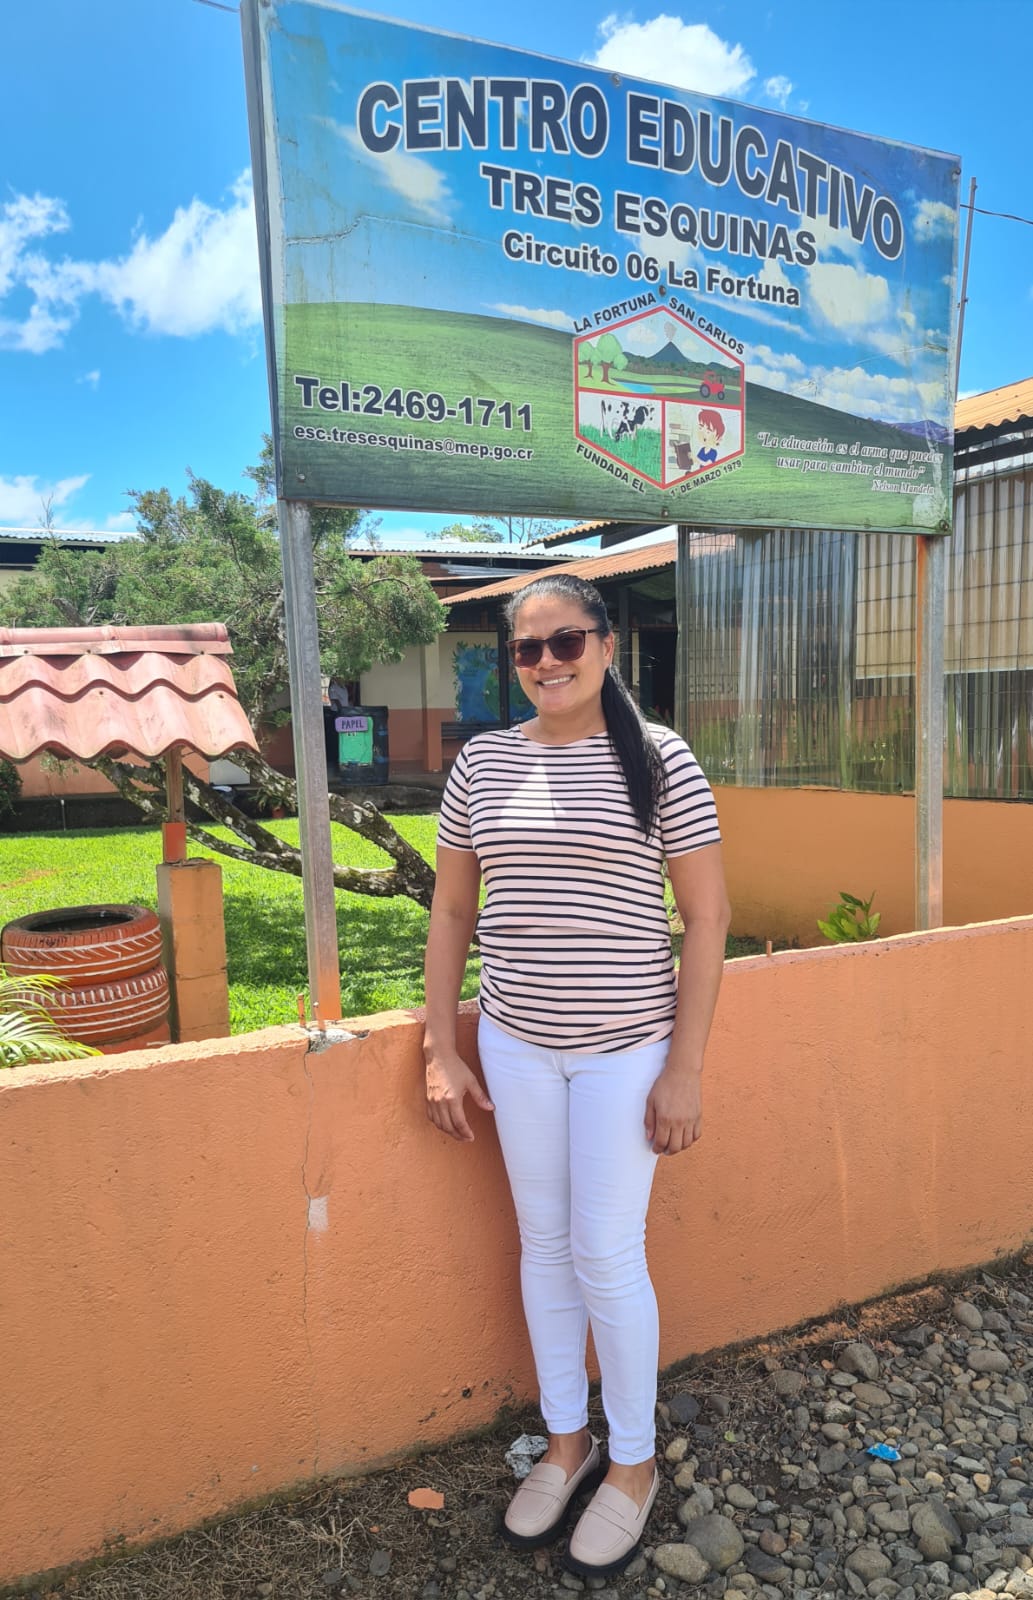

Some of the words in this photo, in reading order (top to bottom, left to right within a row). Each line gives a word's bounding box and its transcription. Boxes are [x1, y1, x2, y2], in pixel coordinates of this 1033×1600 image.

[357, 77, 610, 158] CENTRO
[627, 91, 904, 261] EDUCATIVO
[480, 162, 601, 228] TRES
[614, 191, 818, 266] ESQUINAS
[503, 230, 619, 275] Circuito
[627, 253, 660, 282] 06
[668, 260, 698, 289] La
[707, 267, 800, 306] Fortuna
[573, 318, 592, 333] LA
[594, 292, 656, 325] FORTUNA
[668, 297, 695, 322] SAN
[697, 317, 745, 355] CARLOS
[294, 375, 533, 431] Tel:2469-1711
[294, 425, 534, 460] esc.tresesquinas@mep.go.cr
[780, 435, 834, 453] educación
[836, 443, 848, 454] es
[849, 442, 860, 456] el
[861, 446, 888, 458] arma
[889, 449, 908, 463] que
[576, 444, 629, 483] FUNDADA
[631, 478, 646, 493] EL
[680, 482, 692, 493] DE
[693, 469, 721, 488] MARZO
[723, 459, 742, 473] 1979
[776, 457, 800, 468] usar
[801, 459, 828, 473] para
[830, 460, 872, 475] cambiar
[873, 463, 884, 476] el
[341, 719, 364, 729] PAPEL
